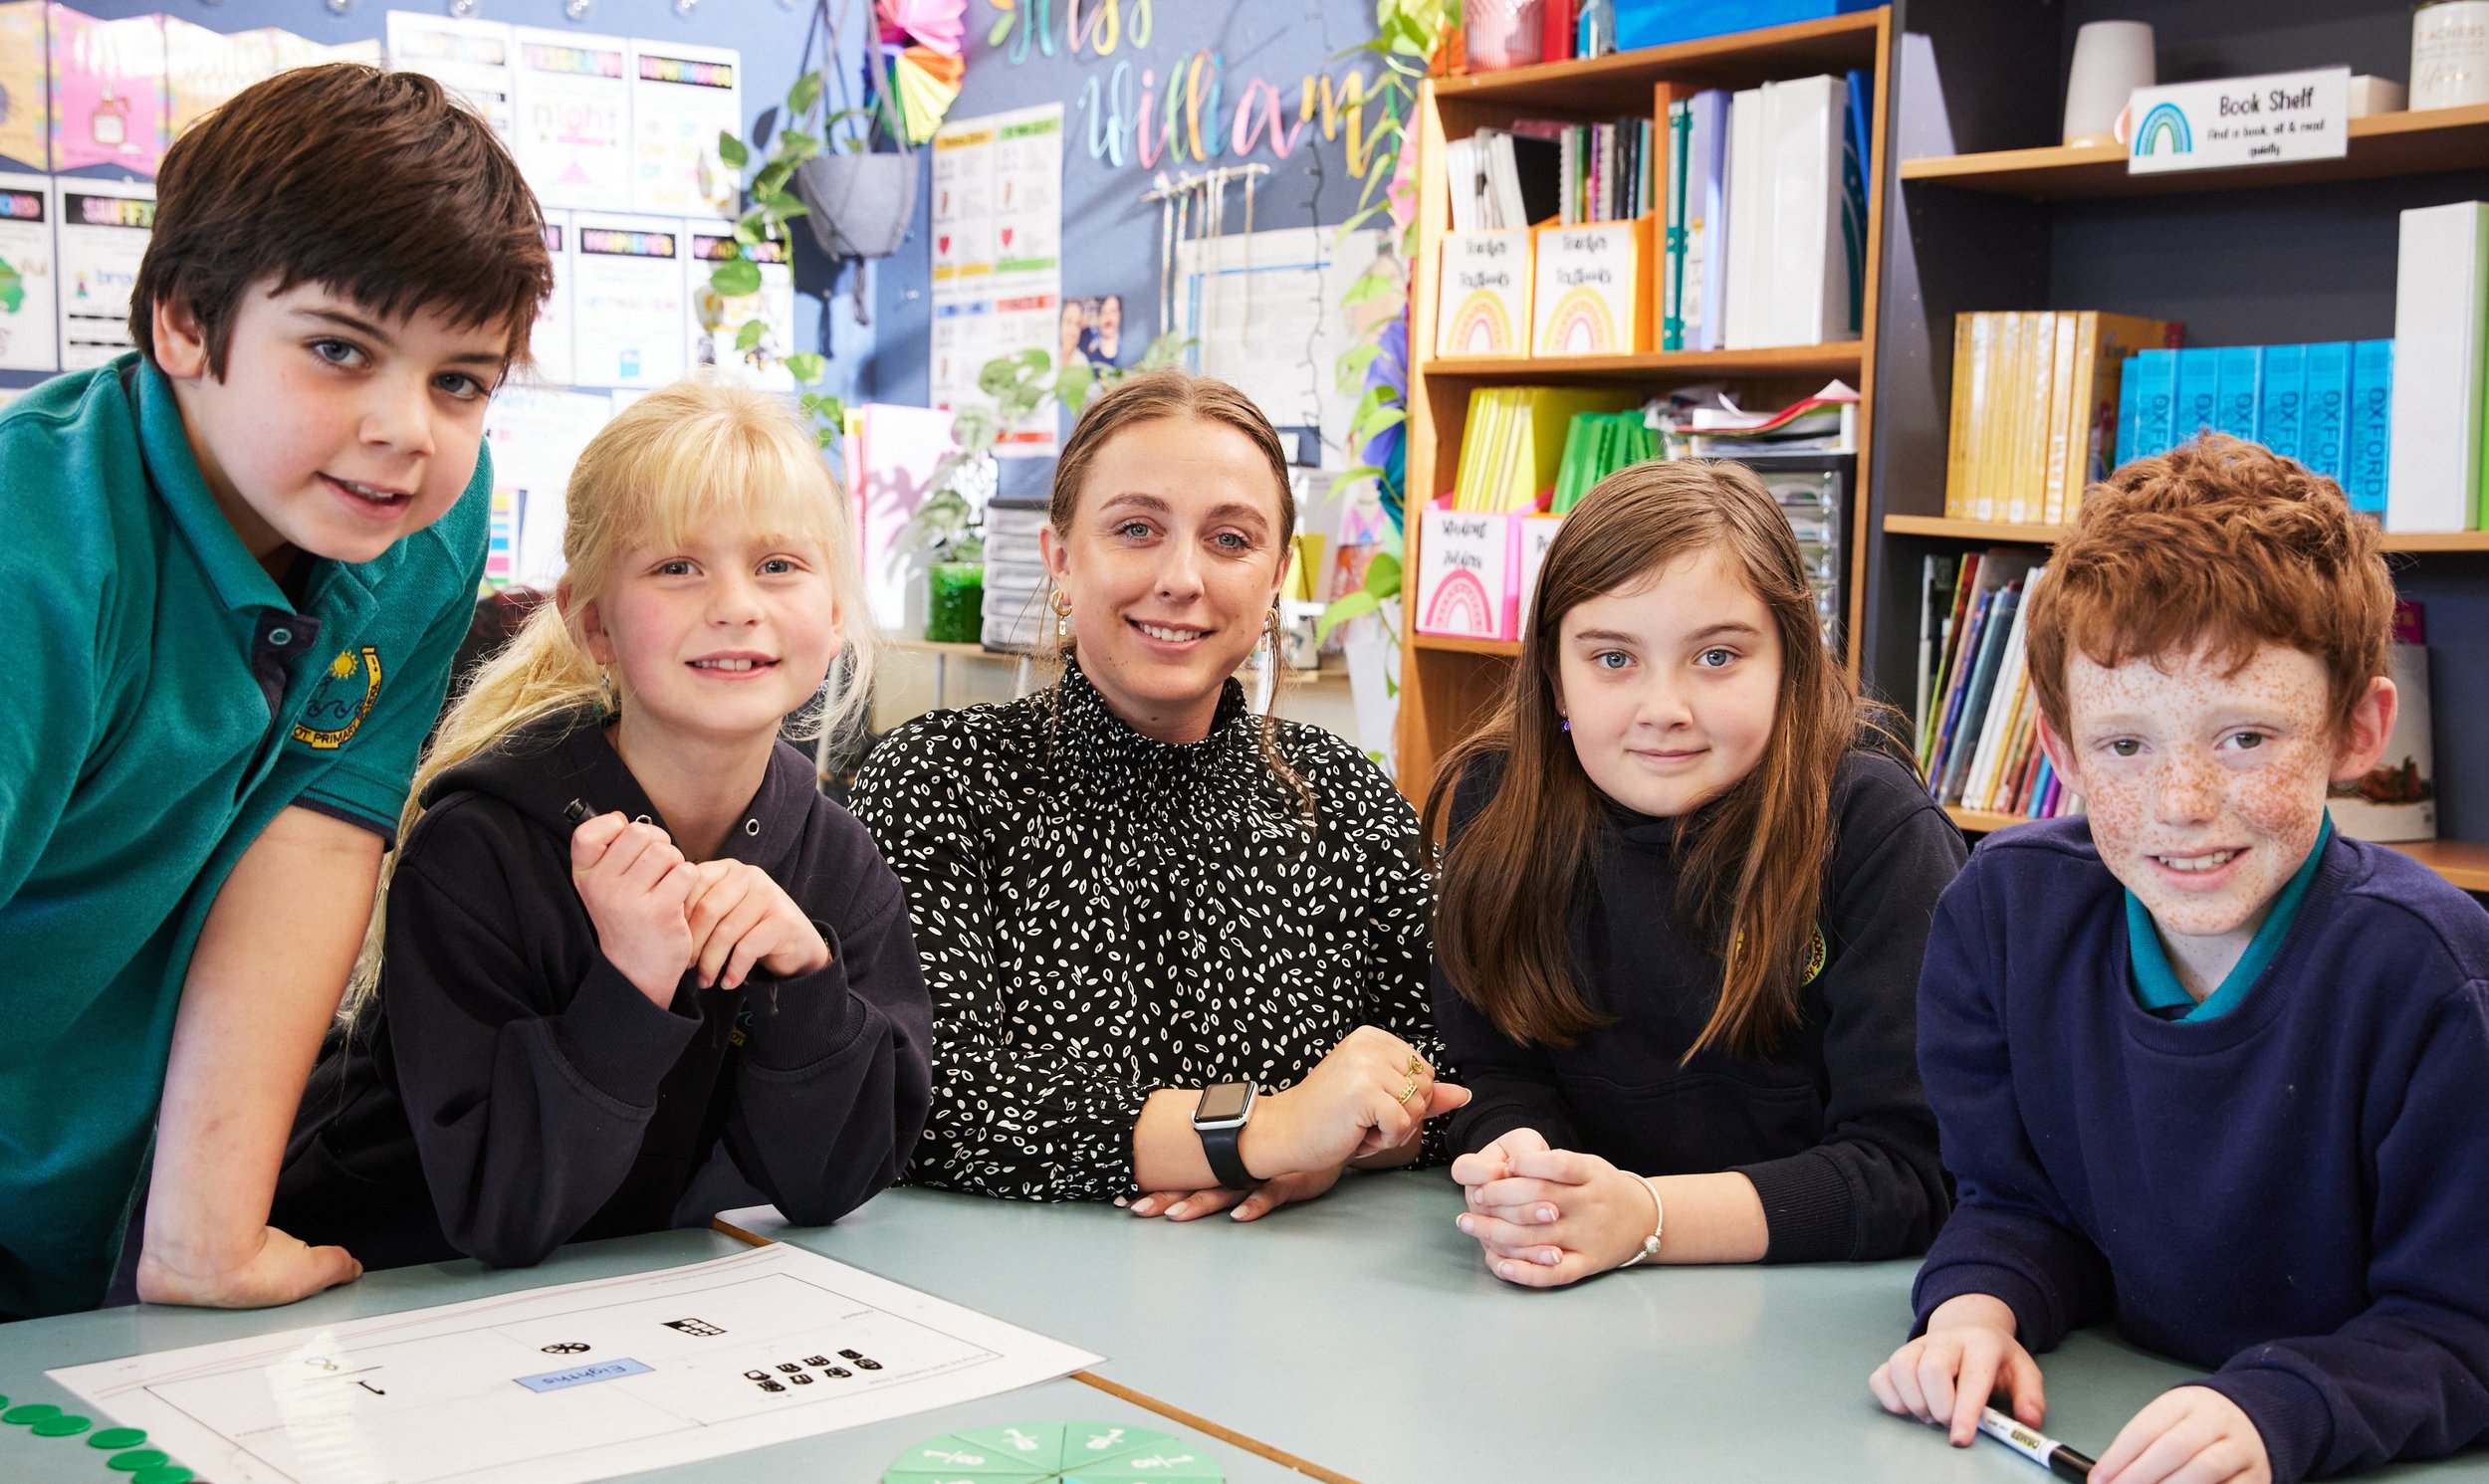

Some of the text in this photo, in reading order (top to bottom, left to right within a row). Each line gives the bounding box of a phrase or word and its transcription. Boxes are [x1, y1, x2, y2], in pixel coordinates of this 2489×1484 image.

[2219, 87, 2314, 116] Book Shelf
[2149, 393, 2171, 453] OXFO
[2235, 392, 2254, 440] OXF
[2279, 390, 2300, 455] OXFO
[2320, 389, 2342, 478] OXFOR
[2364, 386, 2386, 497] OXFORD
[313, 720, 358, 743] PRIMARY
[543, 1365, 626, 1384] Eighths
